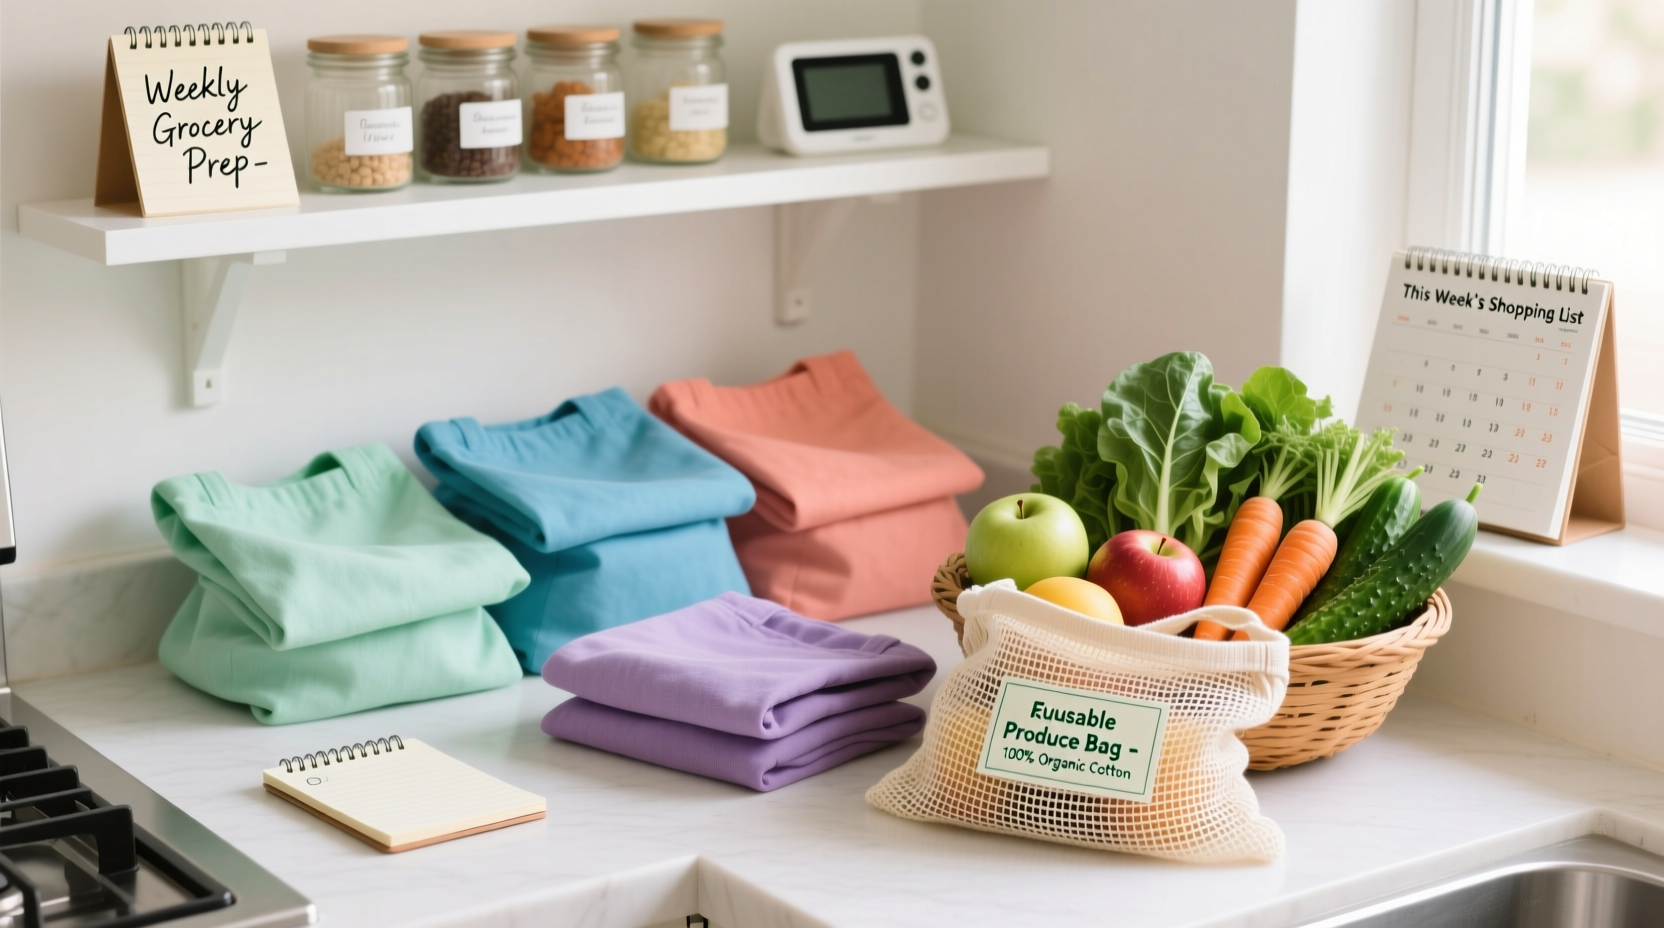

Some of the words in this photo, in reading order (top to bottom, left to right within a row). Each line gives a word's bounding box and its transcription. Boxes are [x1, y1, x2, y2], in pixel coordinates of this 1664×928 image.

[144, 65, 248, 112] Weekly
[152, 111, 263, 148] Grocery
[1403, 283, 1431, 302] This
[1435, 288, 1485, 311] Week's
[1488, 296, 1555, 324] Shopping
[1558, 307, 1584, 325] List
[1003, 720, 1080, 750] Produce
[1084, 733, 1122, 761] Bag
[1003, 746, 1035, 764] 100%
[1038, 752, 1086, 772] Organic
[1089, 761, 1131, 780] Cotton
